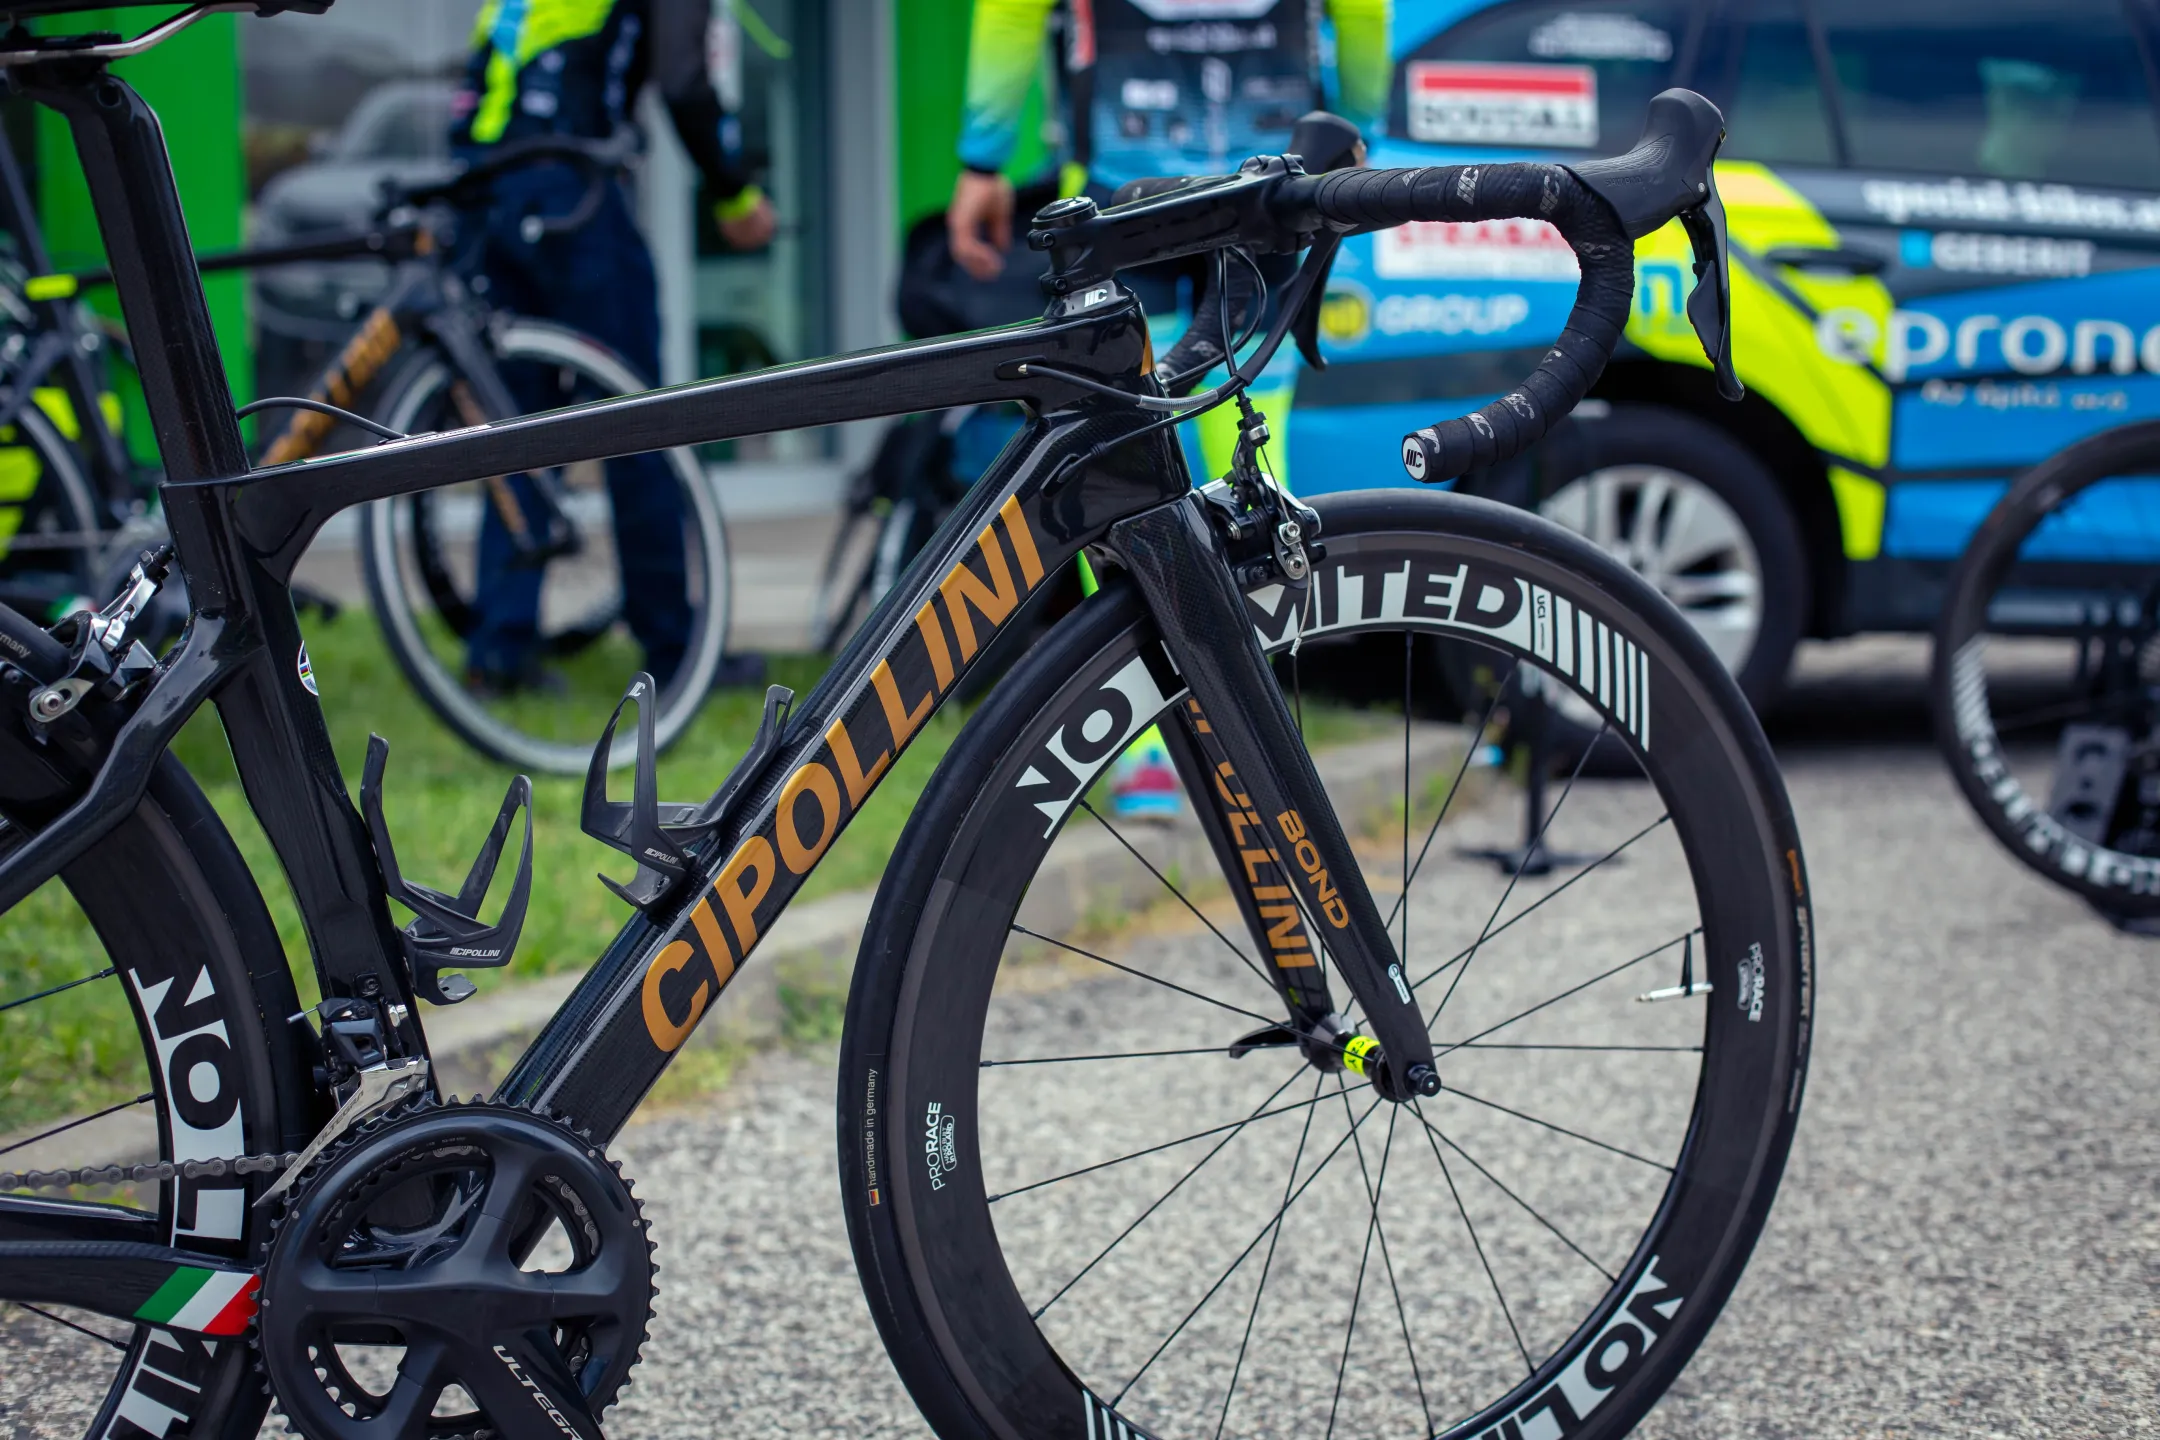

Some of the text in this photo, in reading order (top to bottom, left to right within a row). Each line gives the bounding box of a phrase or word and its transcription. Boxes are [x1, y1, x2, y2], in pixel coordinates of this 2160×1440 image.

[1376, 294, 1529, 335] GROUP
[0, 632, 31, 659] many
[1537, 594, 1546, 618] UCI
[641, 493, 1045, 1053] CIPOLLINI
[1277, 809, 1349, 929] BOND
[1748, 941, 1766, 1023] PRORACE
[317, 1091, 365, 1147] ULTEGRA
[865, 1068, 878, 1187] handmade in germany
[925, 1102, 946, 1191] PRORACE
